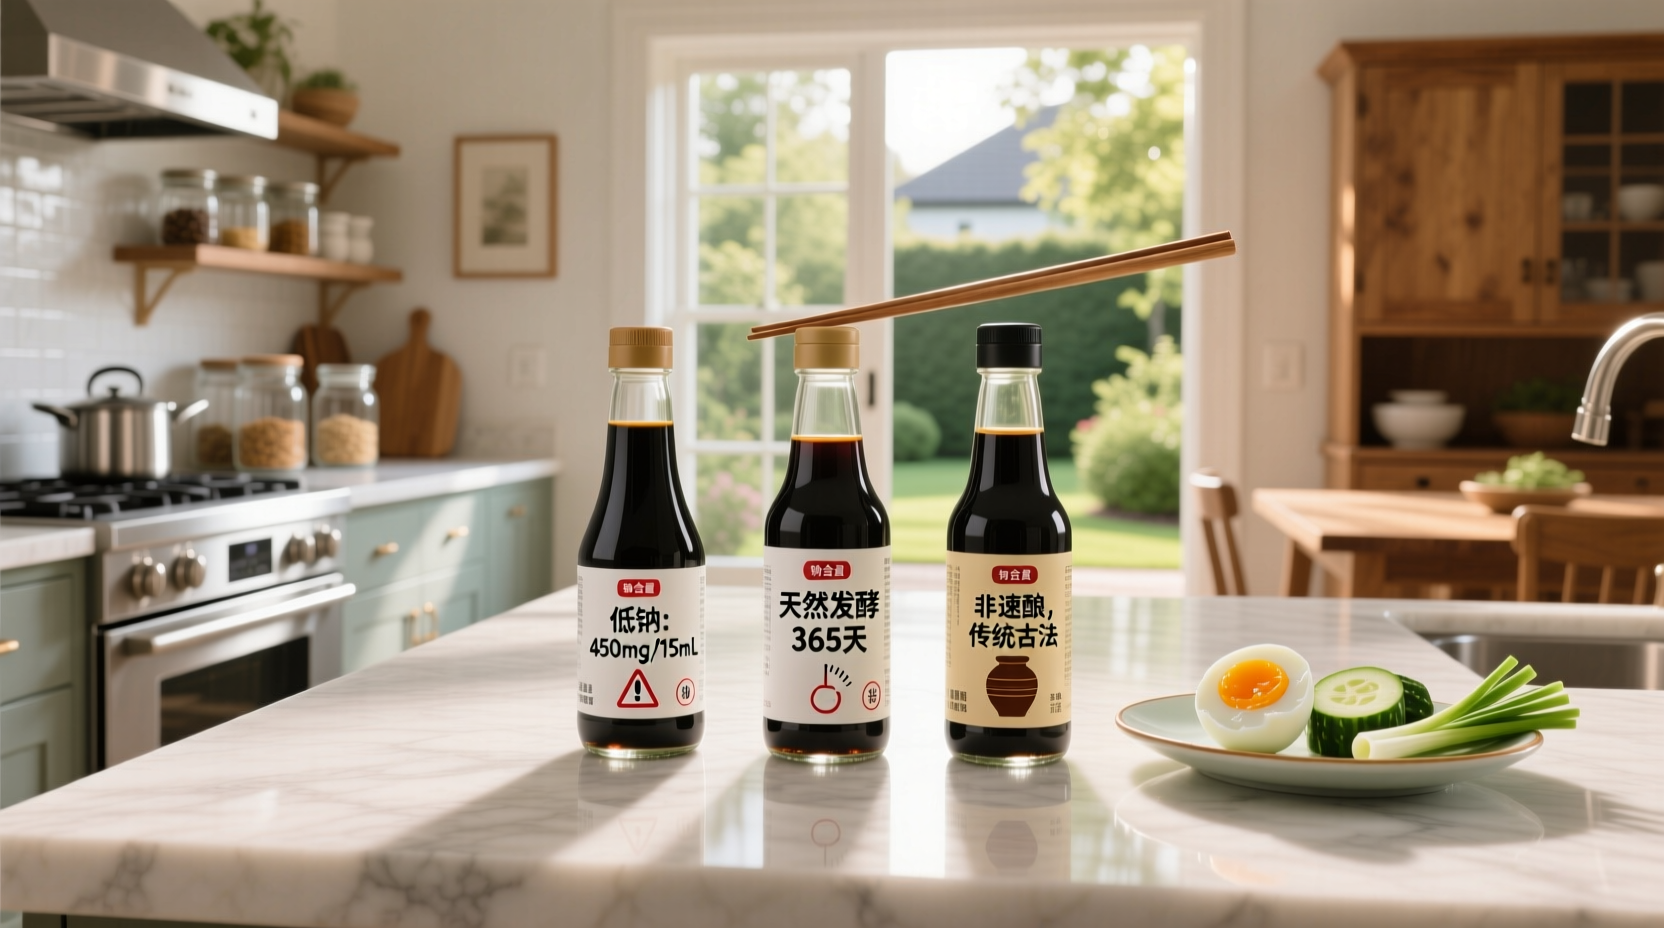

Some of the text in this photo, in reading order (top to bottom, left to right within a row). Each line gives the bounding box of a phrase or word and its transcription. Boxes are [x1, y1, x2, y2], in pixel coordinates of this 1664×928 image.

[779, 589, 879, 620] 天然发酵
[792, 625, 867, 654] 365天
[969, 622, 1058, 649] 传统古法
[590, 637, 698, 664] 450mg/15mL
